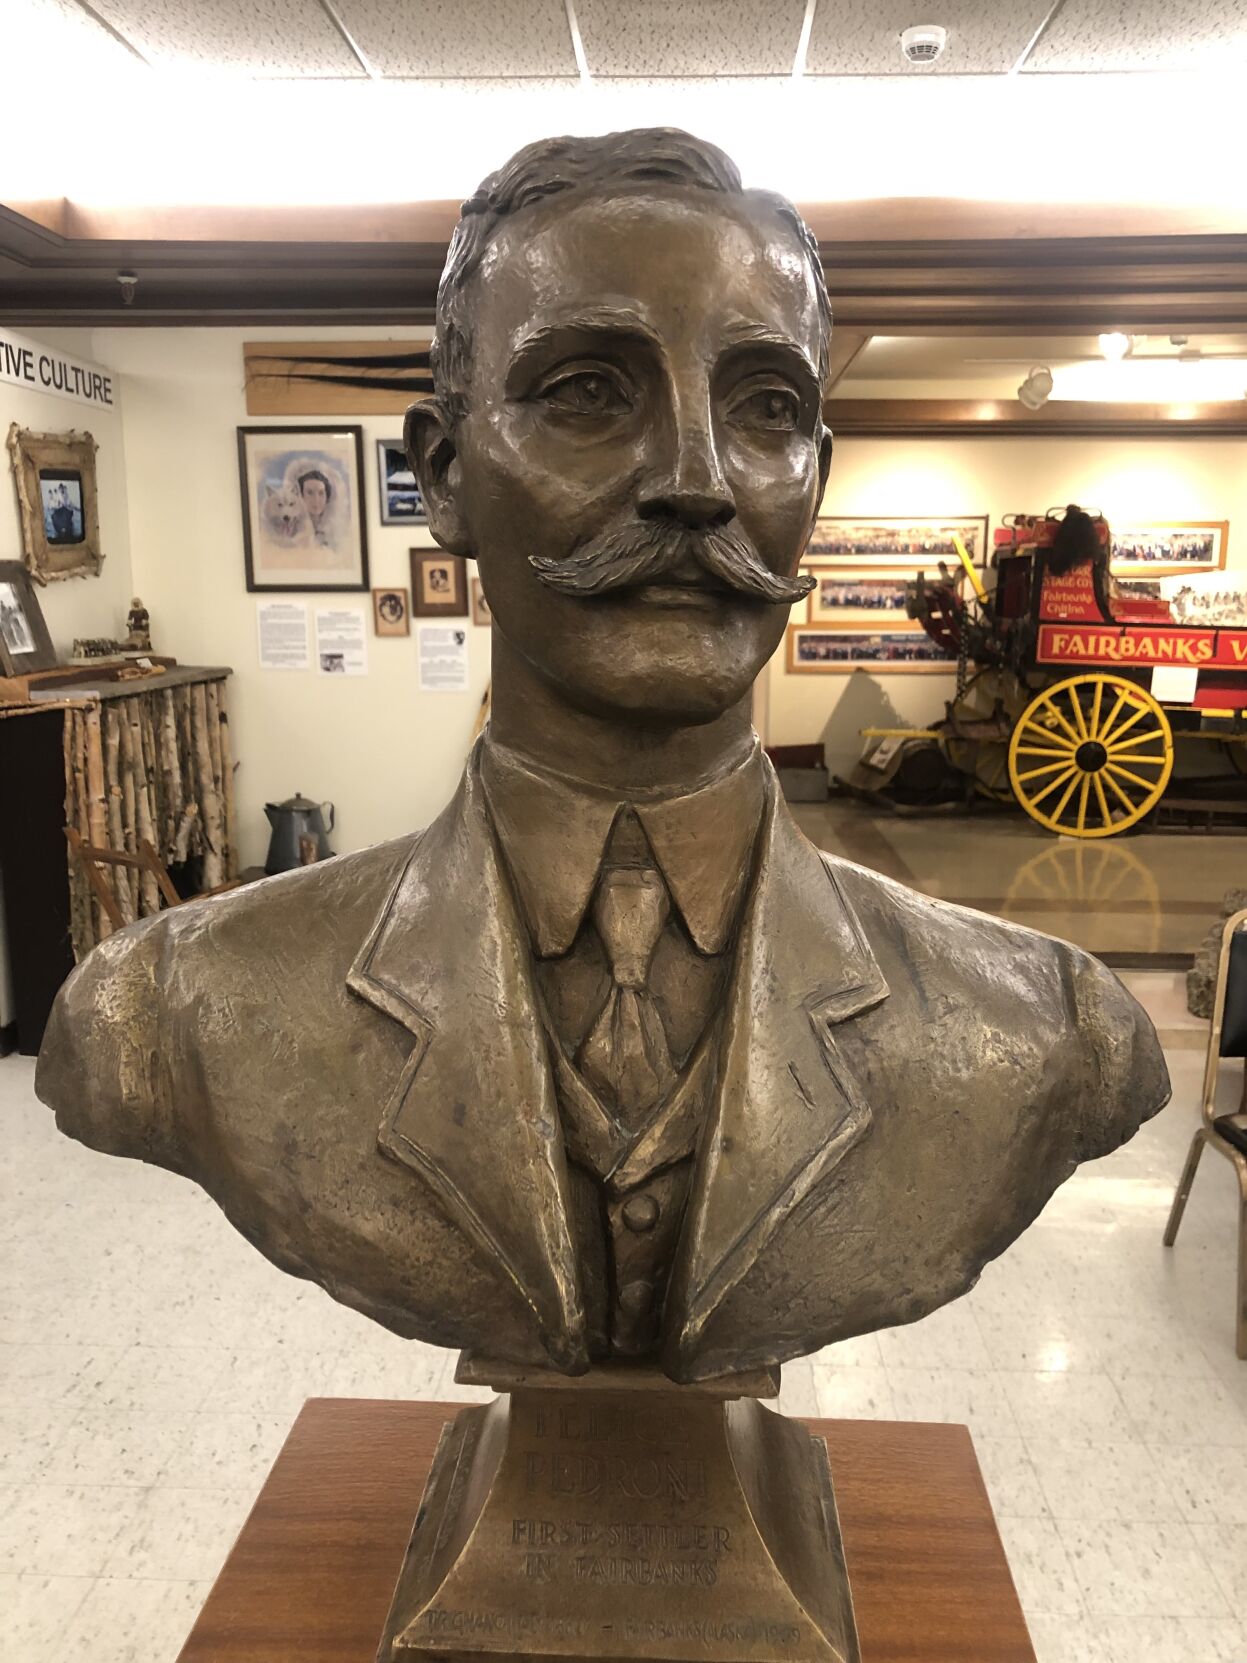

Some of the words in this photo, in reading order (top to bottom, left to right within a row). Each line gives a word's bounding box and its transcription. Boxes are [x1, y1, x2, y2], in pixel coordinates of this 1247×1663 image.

[39, 355, 113, 405] CULTURE
[1052, 634, 1213, 662] FAIRBANKS
[524, 1451, 708, 1500] PEDRONI
[512, 1519, 591, 1546] FIRST
[608, 1520, 732, 1551] SETTLER
[525, 1553, 553, 1578] IN
[575, 1556, 718, 1586] FAIRBANKS
